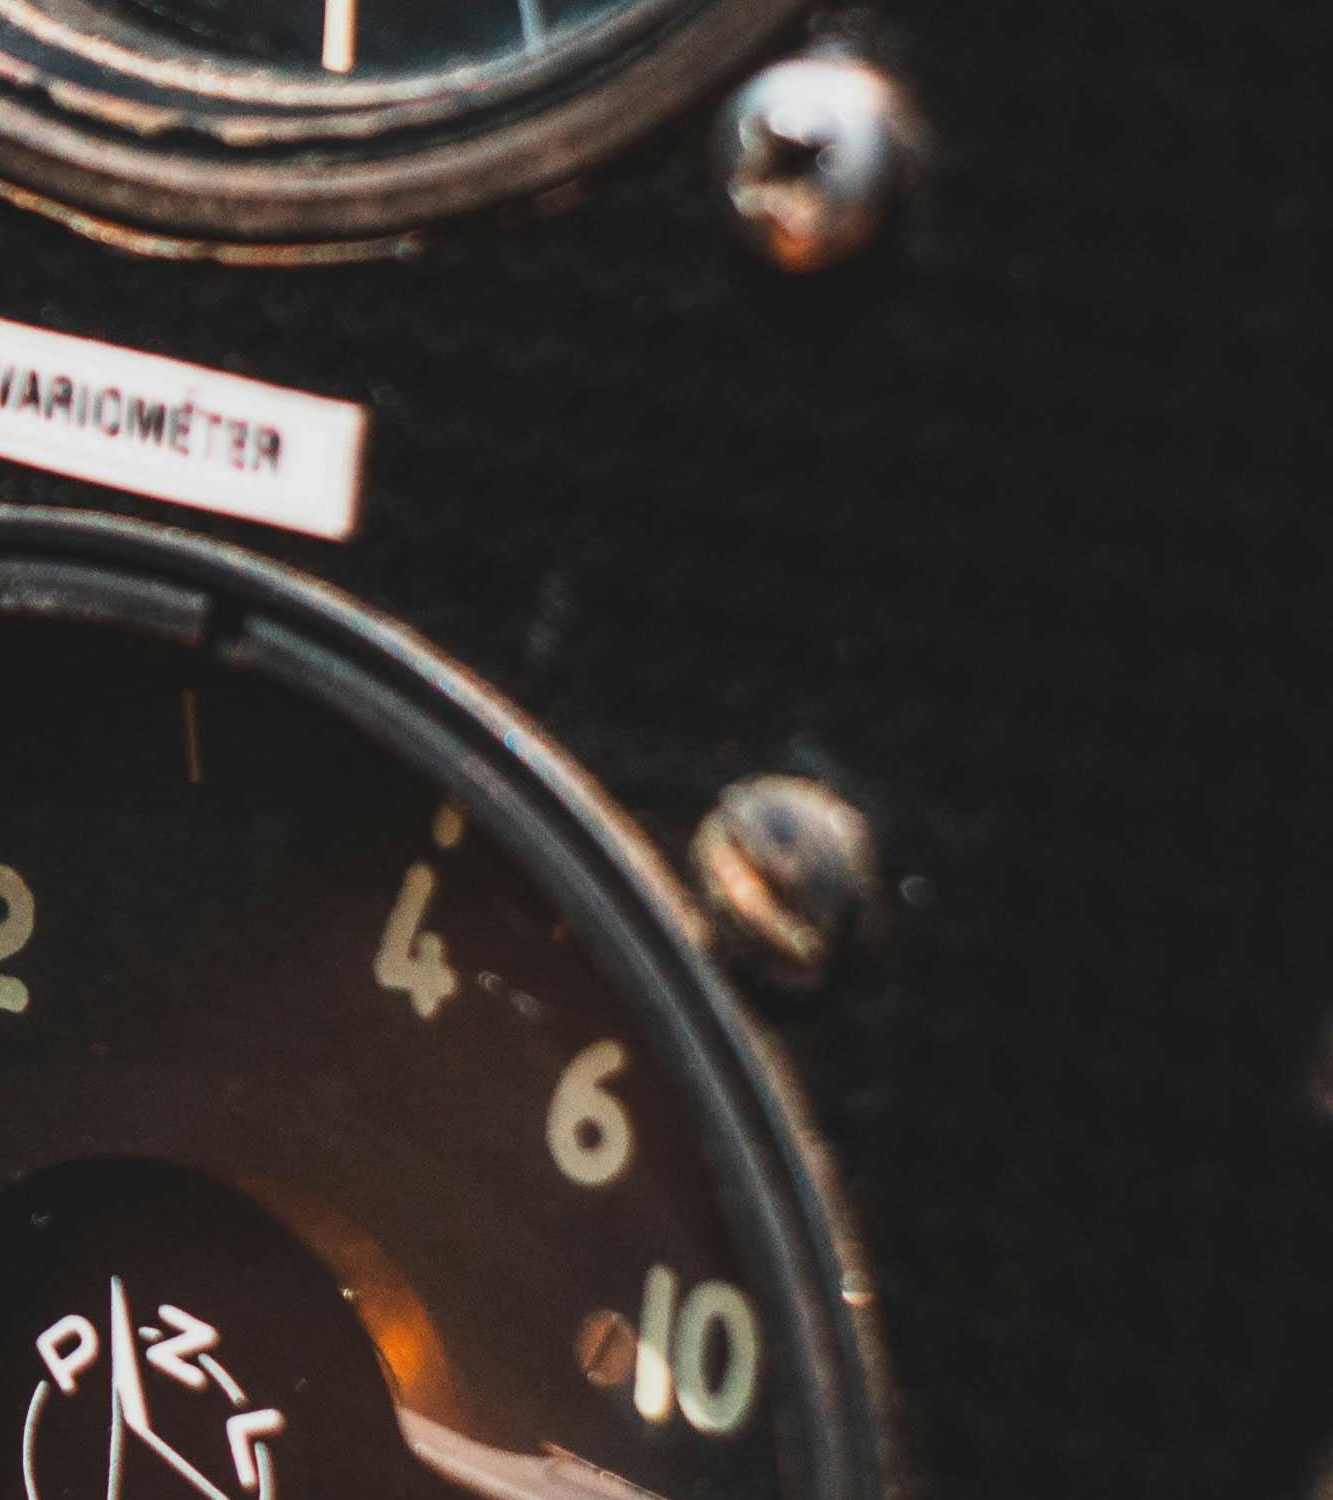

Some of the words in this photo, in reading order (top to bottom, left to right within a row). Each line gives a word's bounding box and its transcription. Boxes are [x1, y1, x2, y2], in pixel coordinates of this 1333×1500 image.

[375, 862, 457, 1020] 4
[547, 1040, 633, 1187] 6
[633, 1264, 761, 1433] 10
